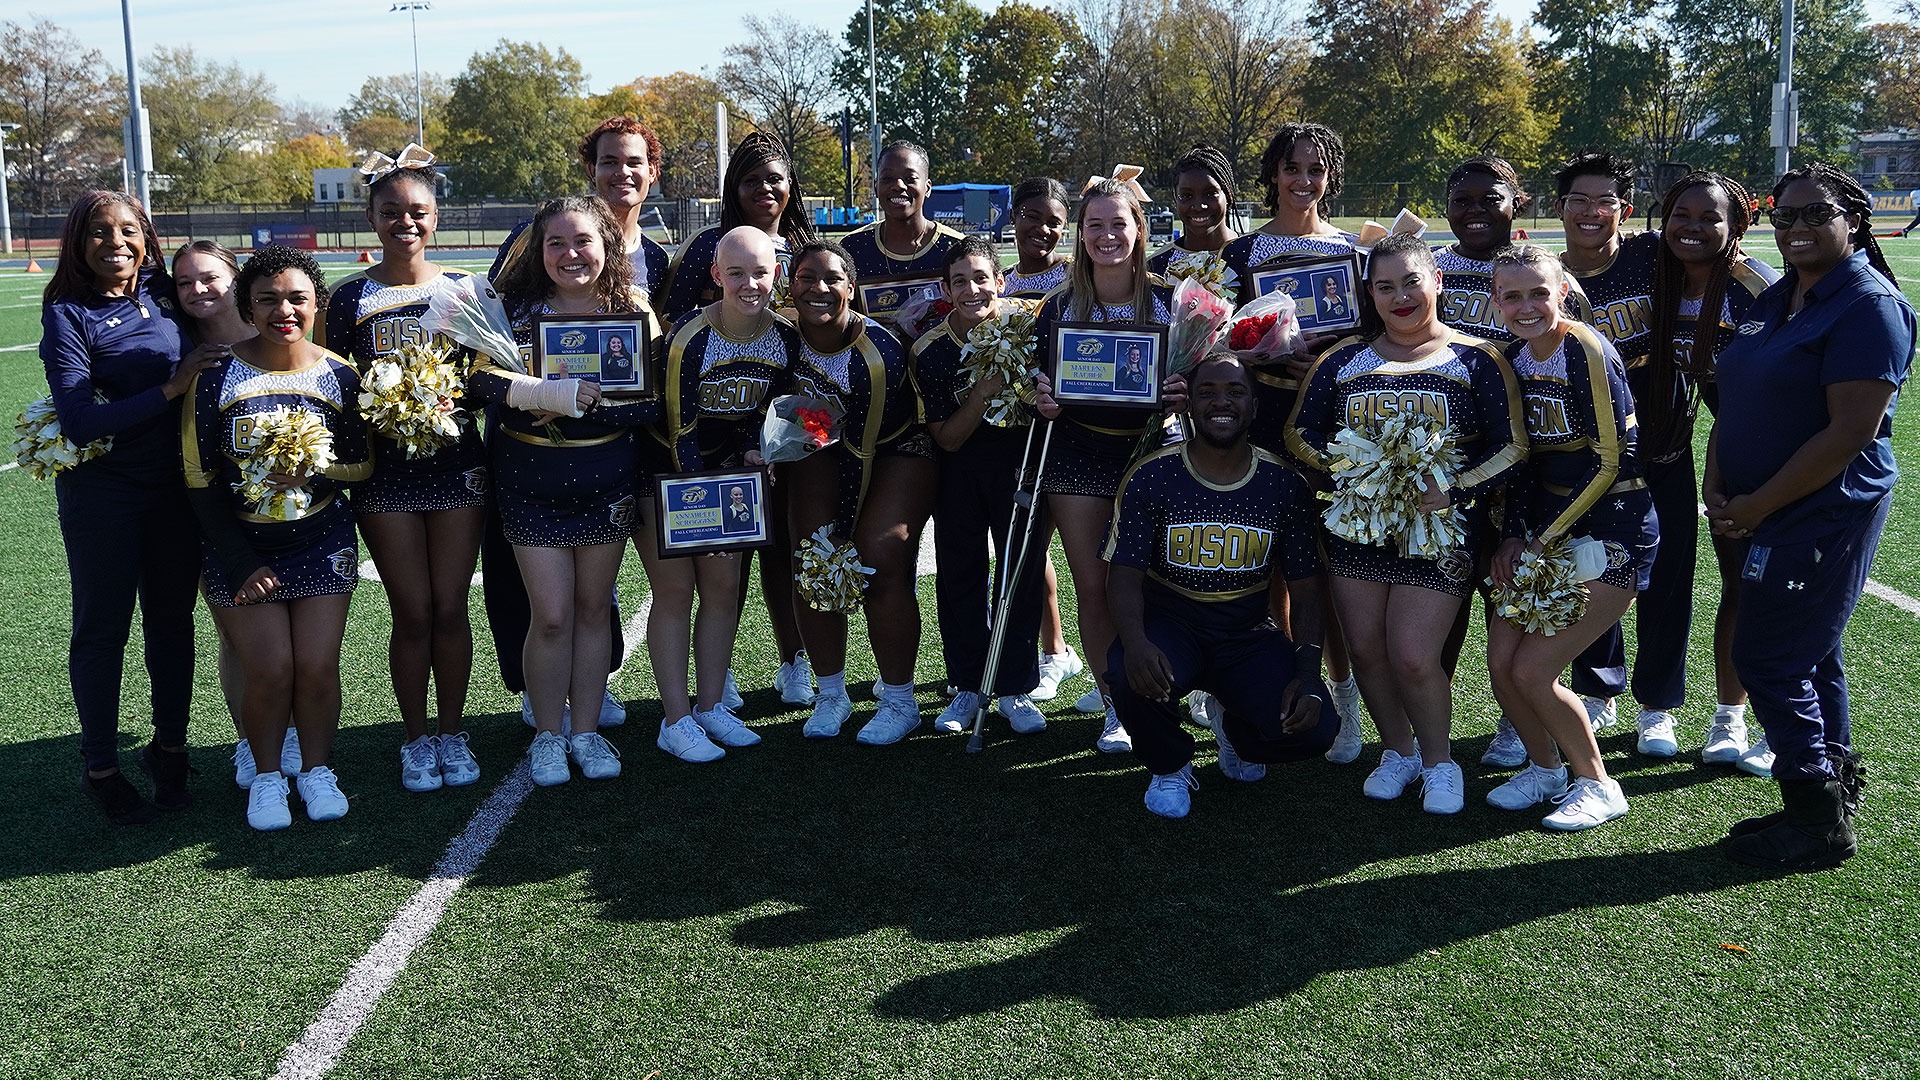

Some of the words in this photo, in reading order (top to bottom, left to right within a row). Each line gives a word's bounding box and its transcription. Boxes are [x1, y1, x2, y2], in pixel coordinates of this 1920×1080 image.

[1442, 289, 1506, 331] SON
[1592, 296, 1652, 344] SON
[699, 378, 769, 410] BISON
[1346, 390, 1449, 431] BISON
[1525, 395, 1573, 436] SON
[674, 510, 717, 520] ANNABELLE
[675, 517, 717, 527] SCROGGINS
[1167, 523, 1272, 570] BISON
